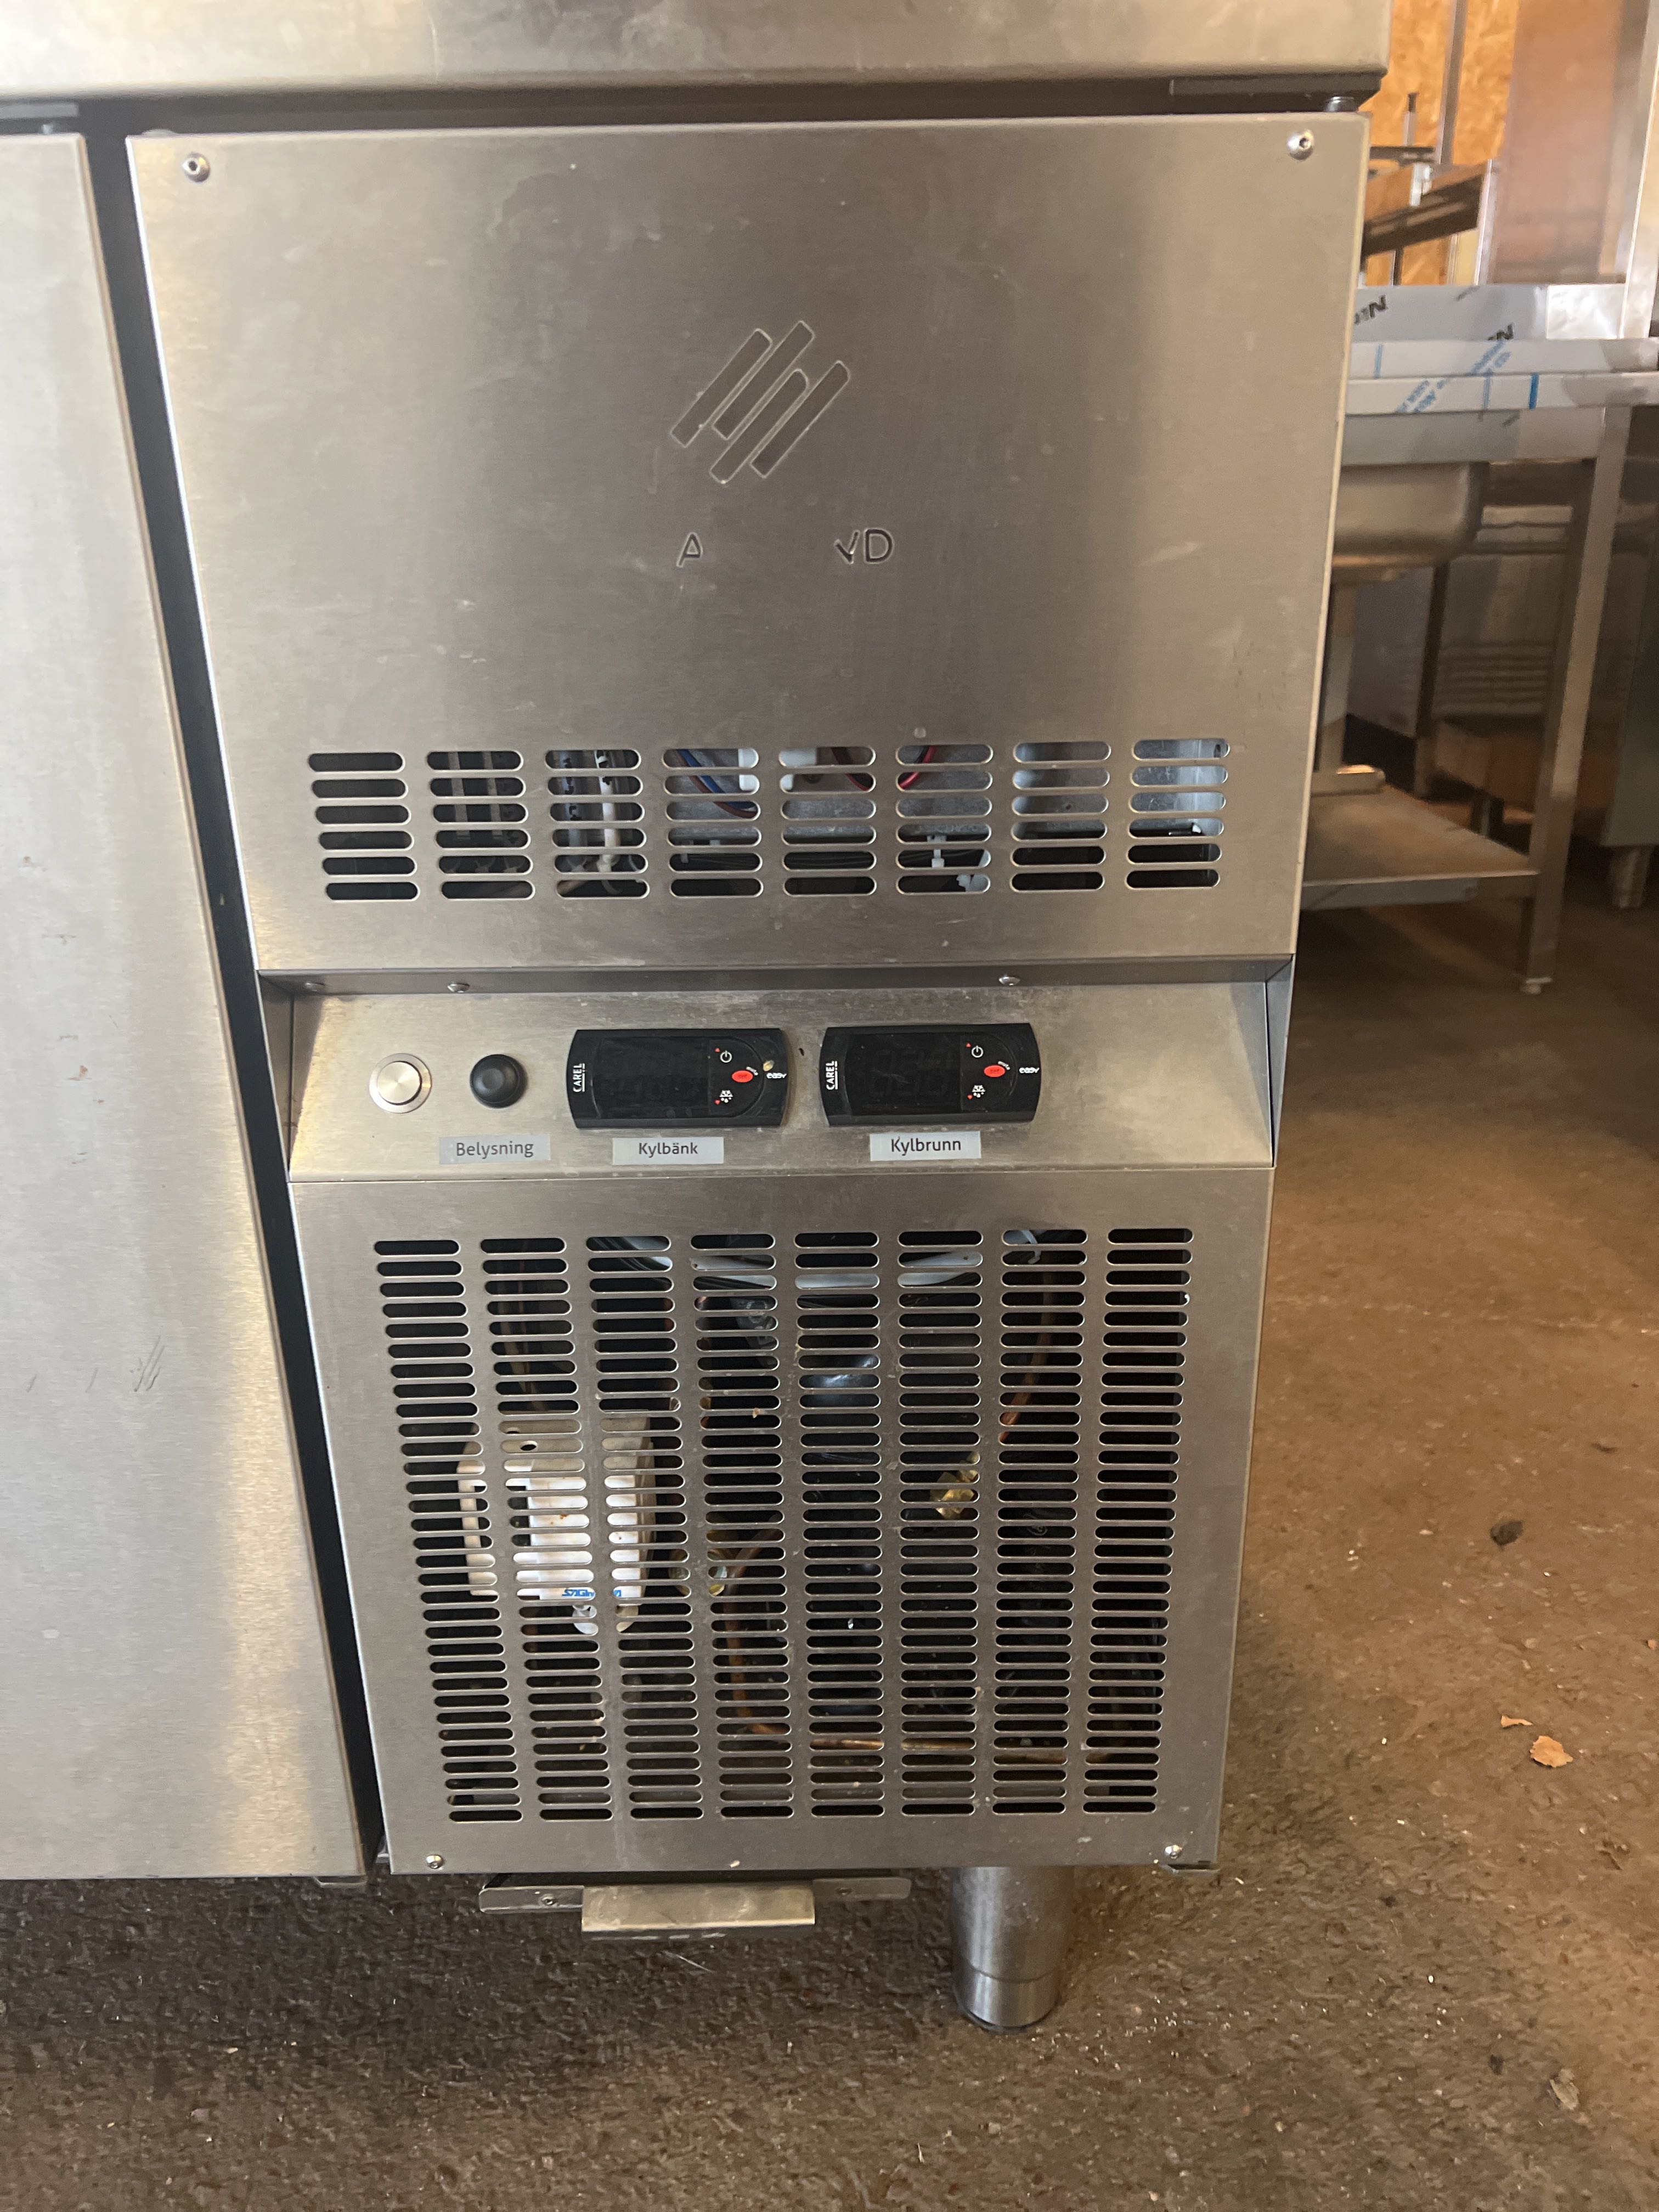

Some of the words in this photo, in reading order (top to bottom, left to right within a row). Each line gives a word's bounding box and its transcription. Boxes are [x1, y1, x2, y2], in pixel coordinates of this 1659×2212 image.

[572, 1063, 583, 1092] CAREL
[825, 1060, 836, 1090] CAREL
[456, 1141, 534, 1159] Belysning
[639, 1142, 698, 1158] Kylbänk
[891, 1136, 961, 1156] Kylbrunn
